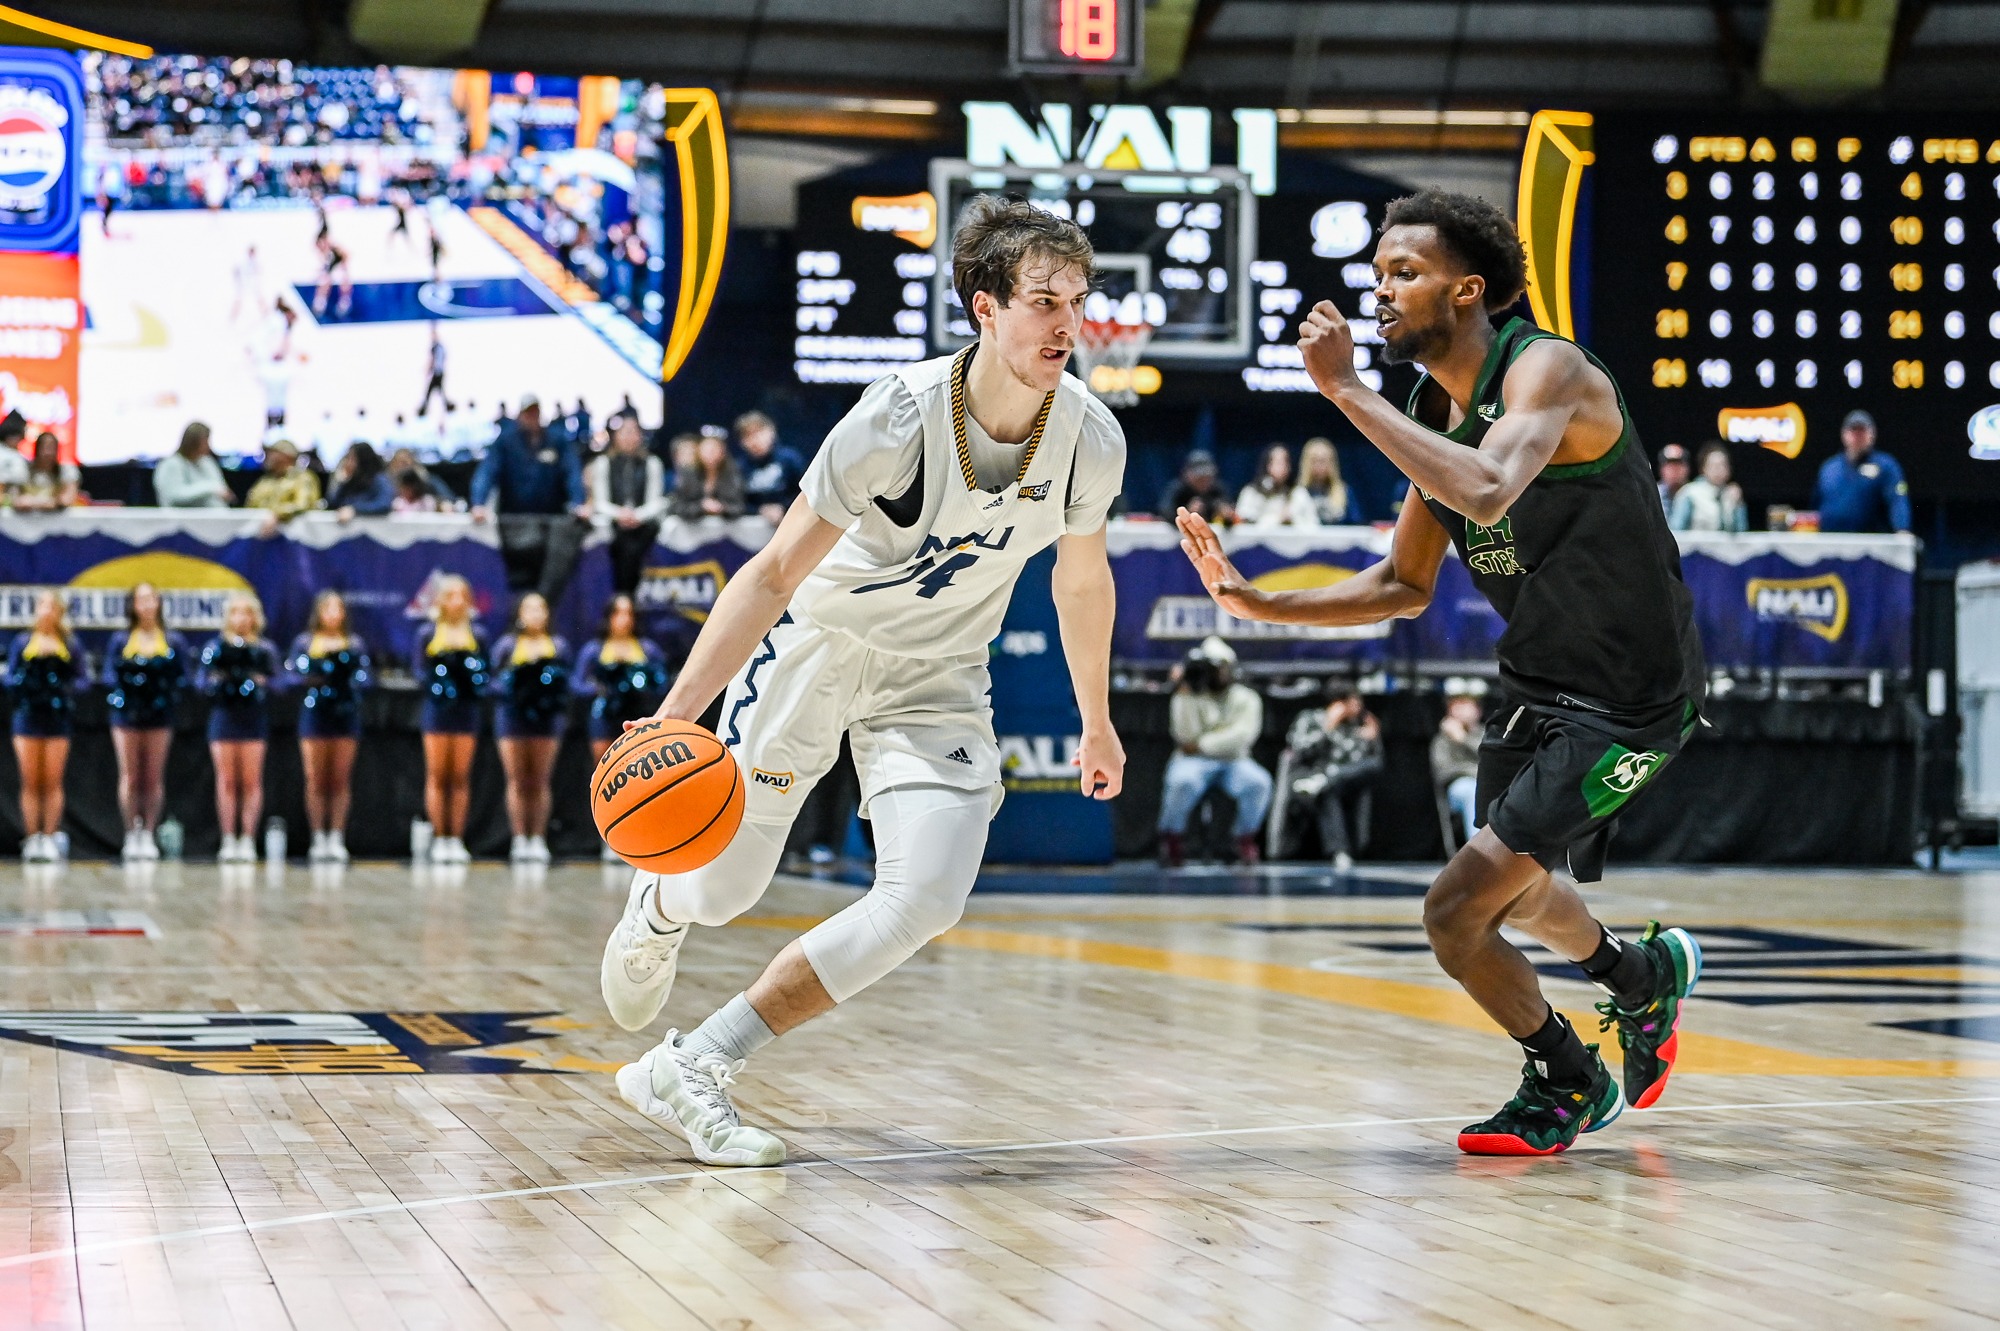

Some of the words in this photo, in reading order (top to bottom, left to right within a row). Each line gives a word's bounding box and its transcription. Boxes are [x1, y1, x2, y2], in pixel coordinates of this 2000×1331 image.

[1060, 0, 1116, 60] 18
[962, 101, 1277, 195] NAU
[1800, 172, 1818, 200] 1
[1901, 172, 1922, 200] 4
[1665, 215, 1687, 244] 4
[1710, 216, 1732, 244] 7
[1794, 216, 1817, 244] 4
[1666, 262, 1688, 290] 7
[1756, 359, 1775, 388] 1
[1844, 360, 1862, 388] 1
[1757, 588, 1834, 617] NAU
[601, 741, 697, 802] Wilson
[755, 772, 790, 787] NAU
